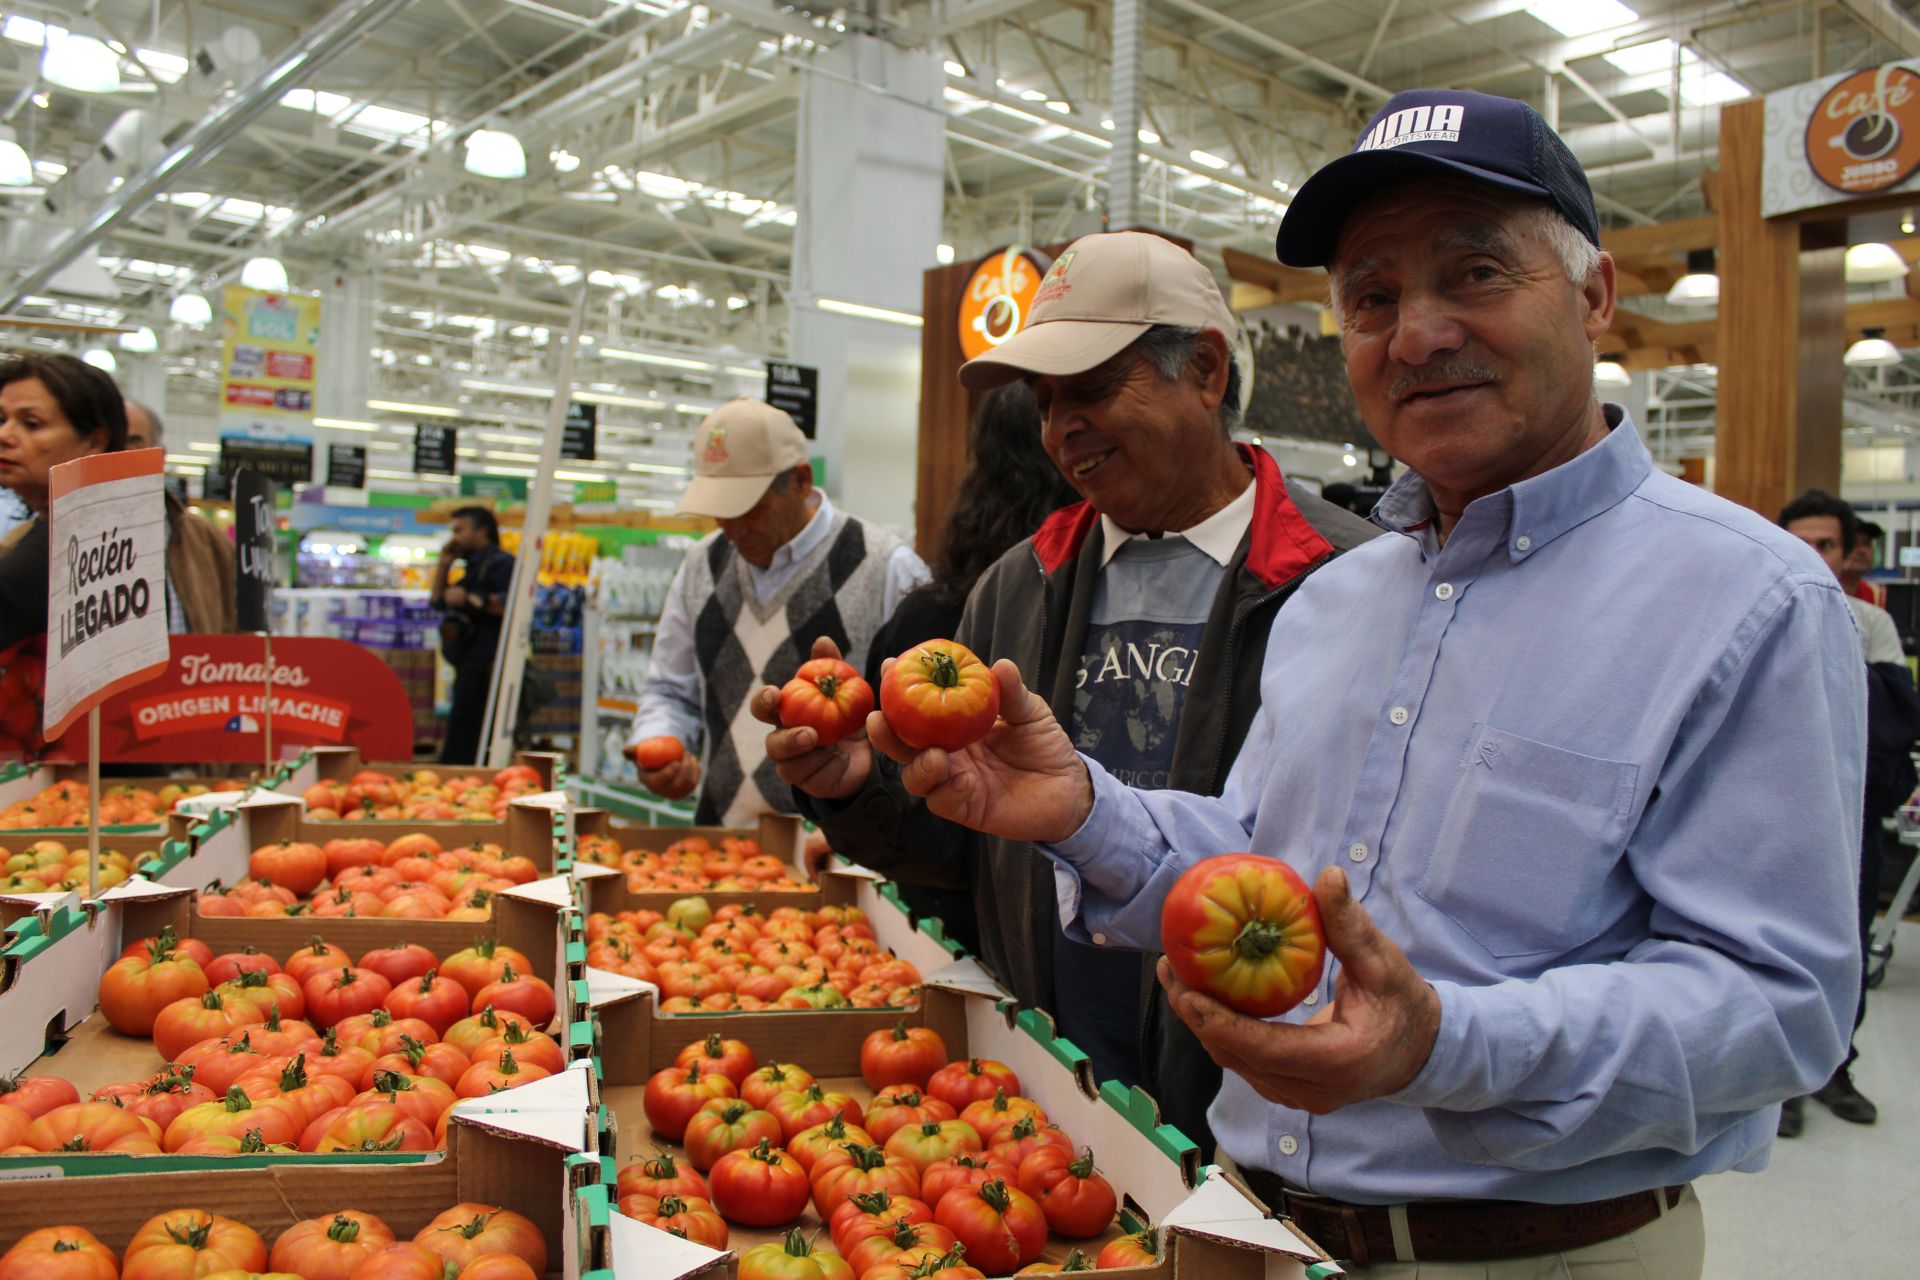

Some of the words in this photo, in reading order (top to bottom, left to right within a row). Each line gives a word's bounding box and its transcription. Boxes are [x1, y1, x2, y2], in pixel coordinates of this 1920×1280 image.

[1826, 66, 1915, 119] Café
[1357, 105, 1464, 152] UMA
[972, 249, 1028, 302] Café
[67, 526, 137, 596] Recién
[60, 578, 150, 660] LLEGADO
[180, 652, 310, 687] Tomates
[138, 695, 230, 726] ORIGEN
[238, 695, 344, 728] LIMACHE
